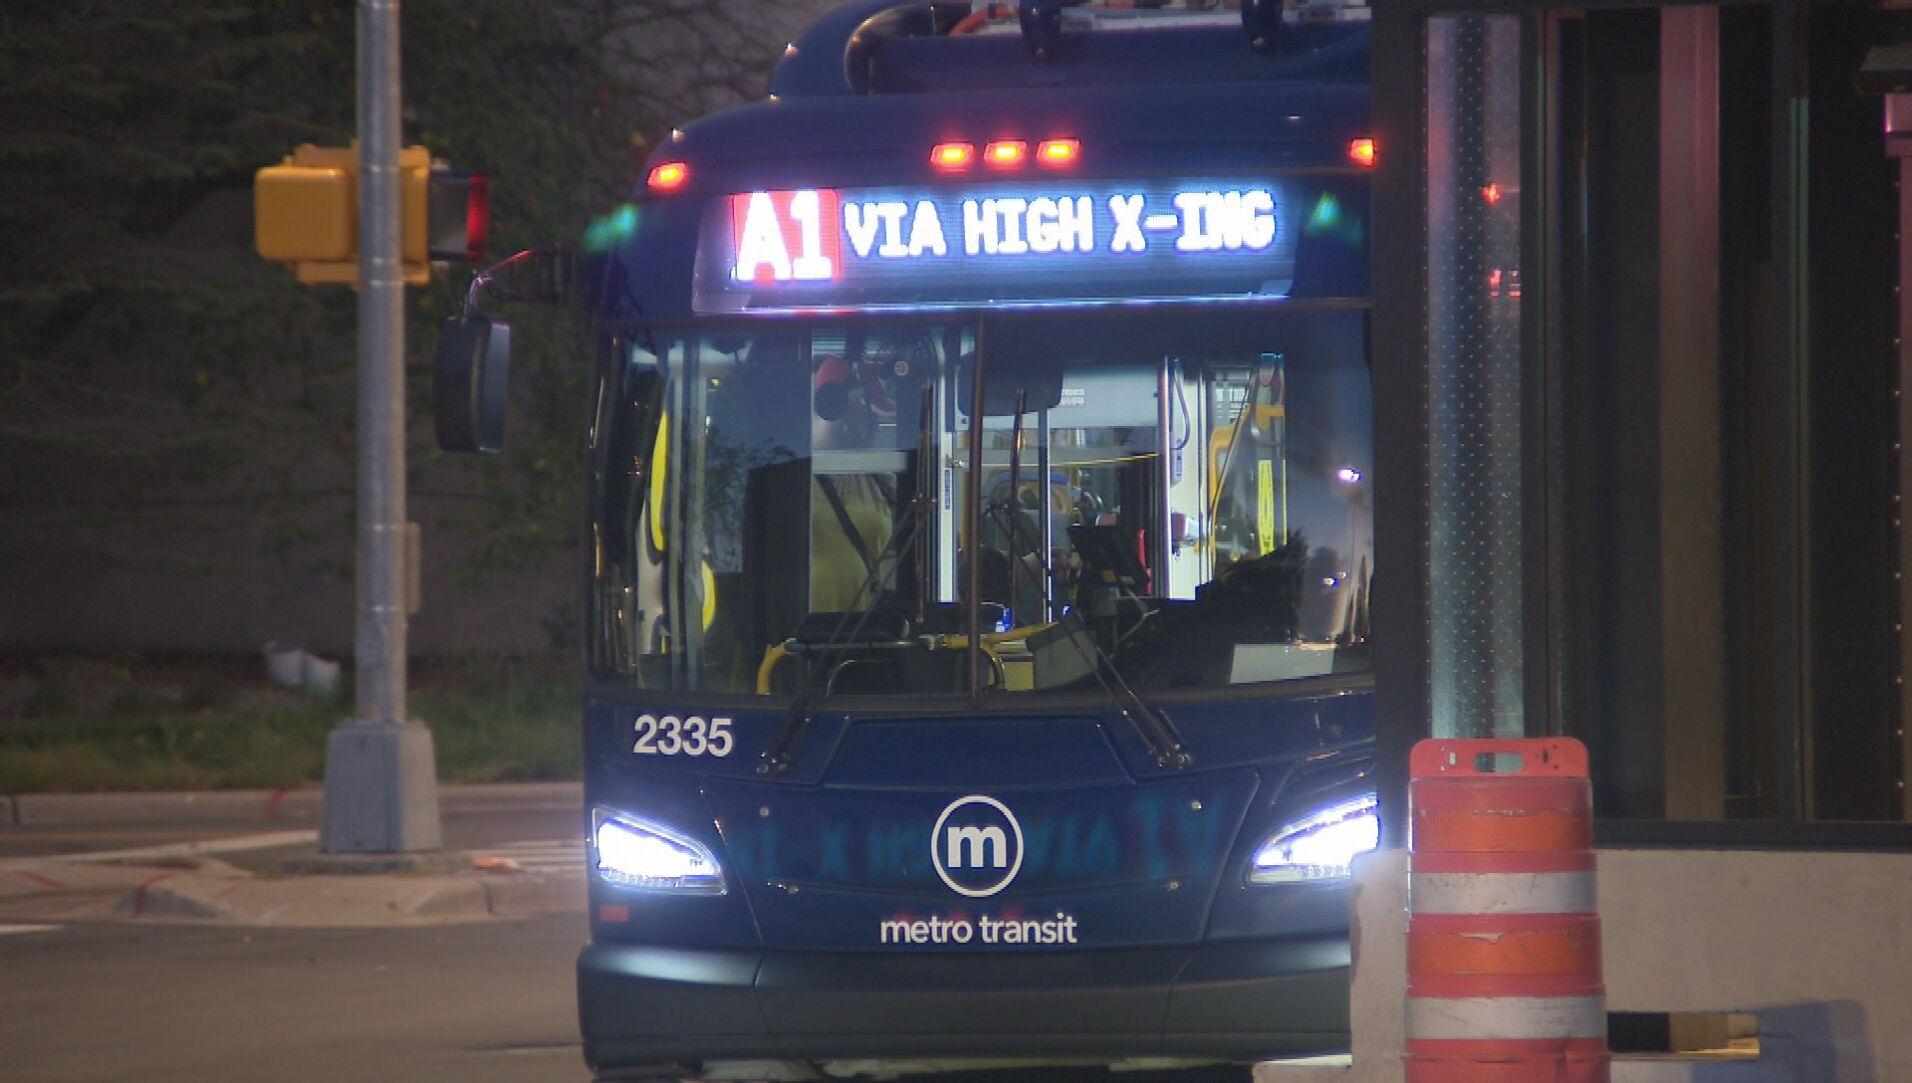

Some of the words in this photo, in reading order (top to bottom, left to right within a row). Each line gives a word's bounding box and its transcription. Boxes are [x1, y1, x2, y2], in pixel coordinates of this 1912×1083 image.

[735, 190, 833, 281] A1
[844, 200, 946, 257] VIA
[963, 197, 1094, 254] HIGH
[1109, 190, 1276, 253] X-ING
[633, 714, 733, 757] 2335
[947, 826, 1007, 868] m
[880, 915, 973, 944] metro
[978, 912, 1078, 944] transit
